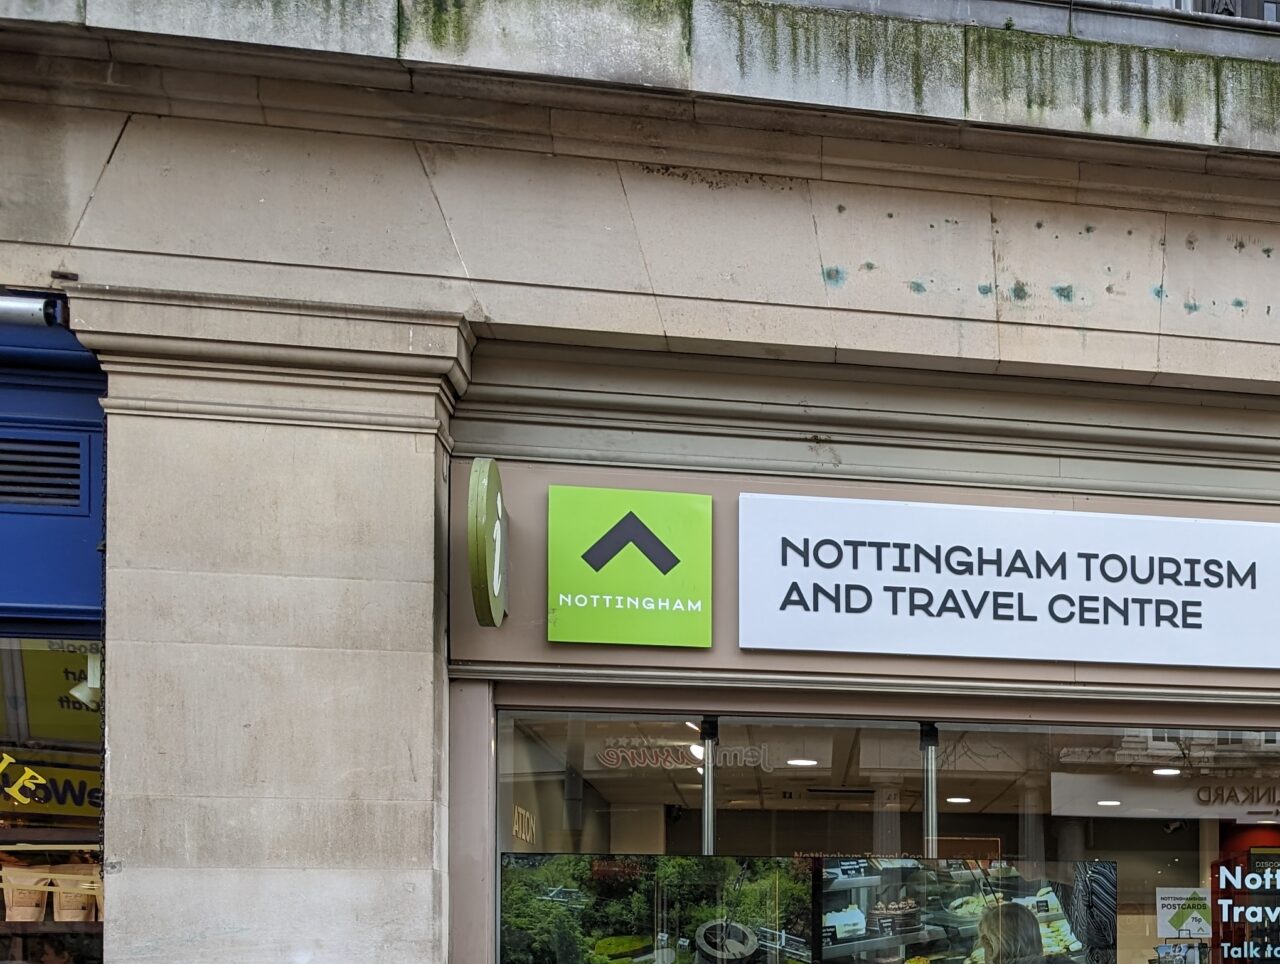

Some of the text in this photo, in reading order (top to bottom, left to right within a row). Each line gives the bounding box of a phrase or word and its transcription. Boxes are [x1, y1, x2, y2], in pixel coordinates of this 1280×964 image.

[780, 536, 1257, 589] NOTTINGHAM TOURISM
[559, 593, 702, 612] NOTTINGHAM
[779, 581, 1203, 629] AND TRAVEL CENTRE
[1191, 916, 1203, 924] 75p
[1221, 942, 1260, 958] Talk
